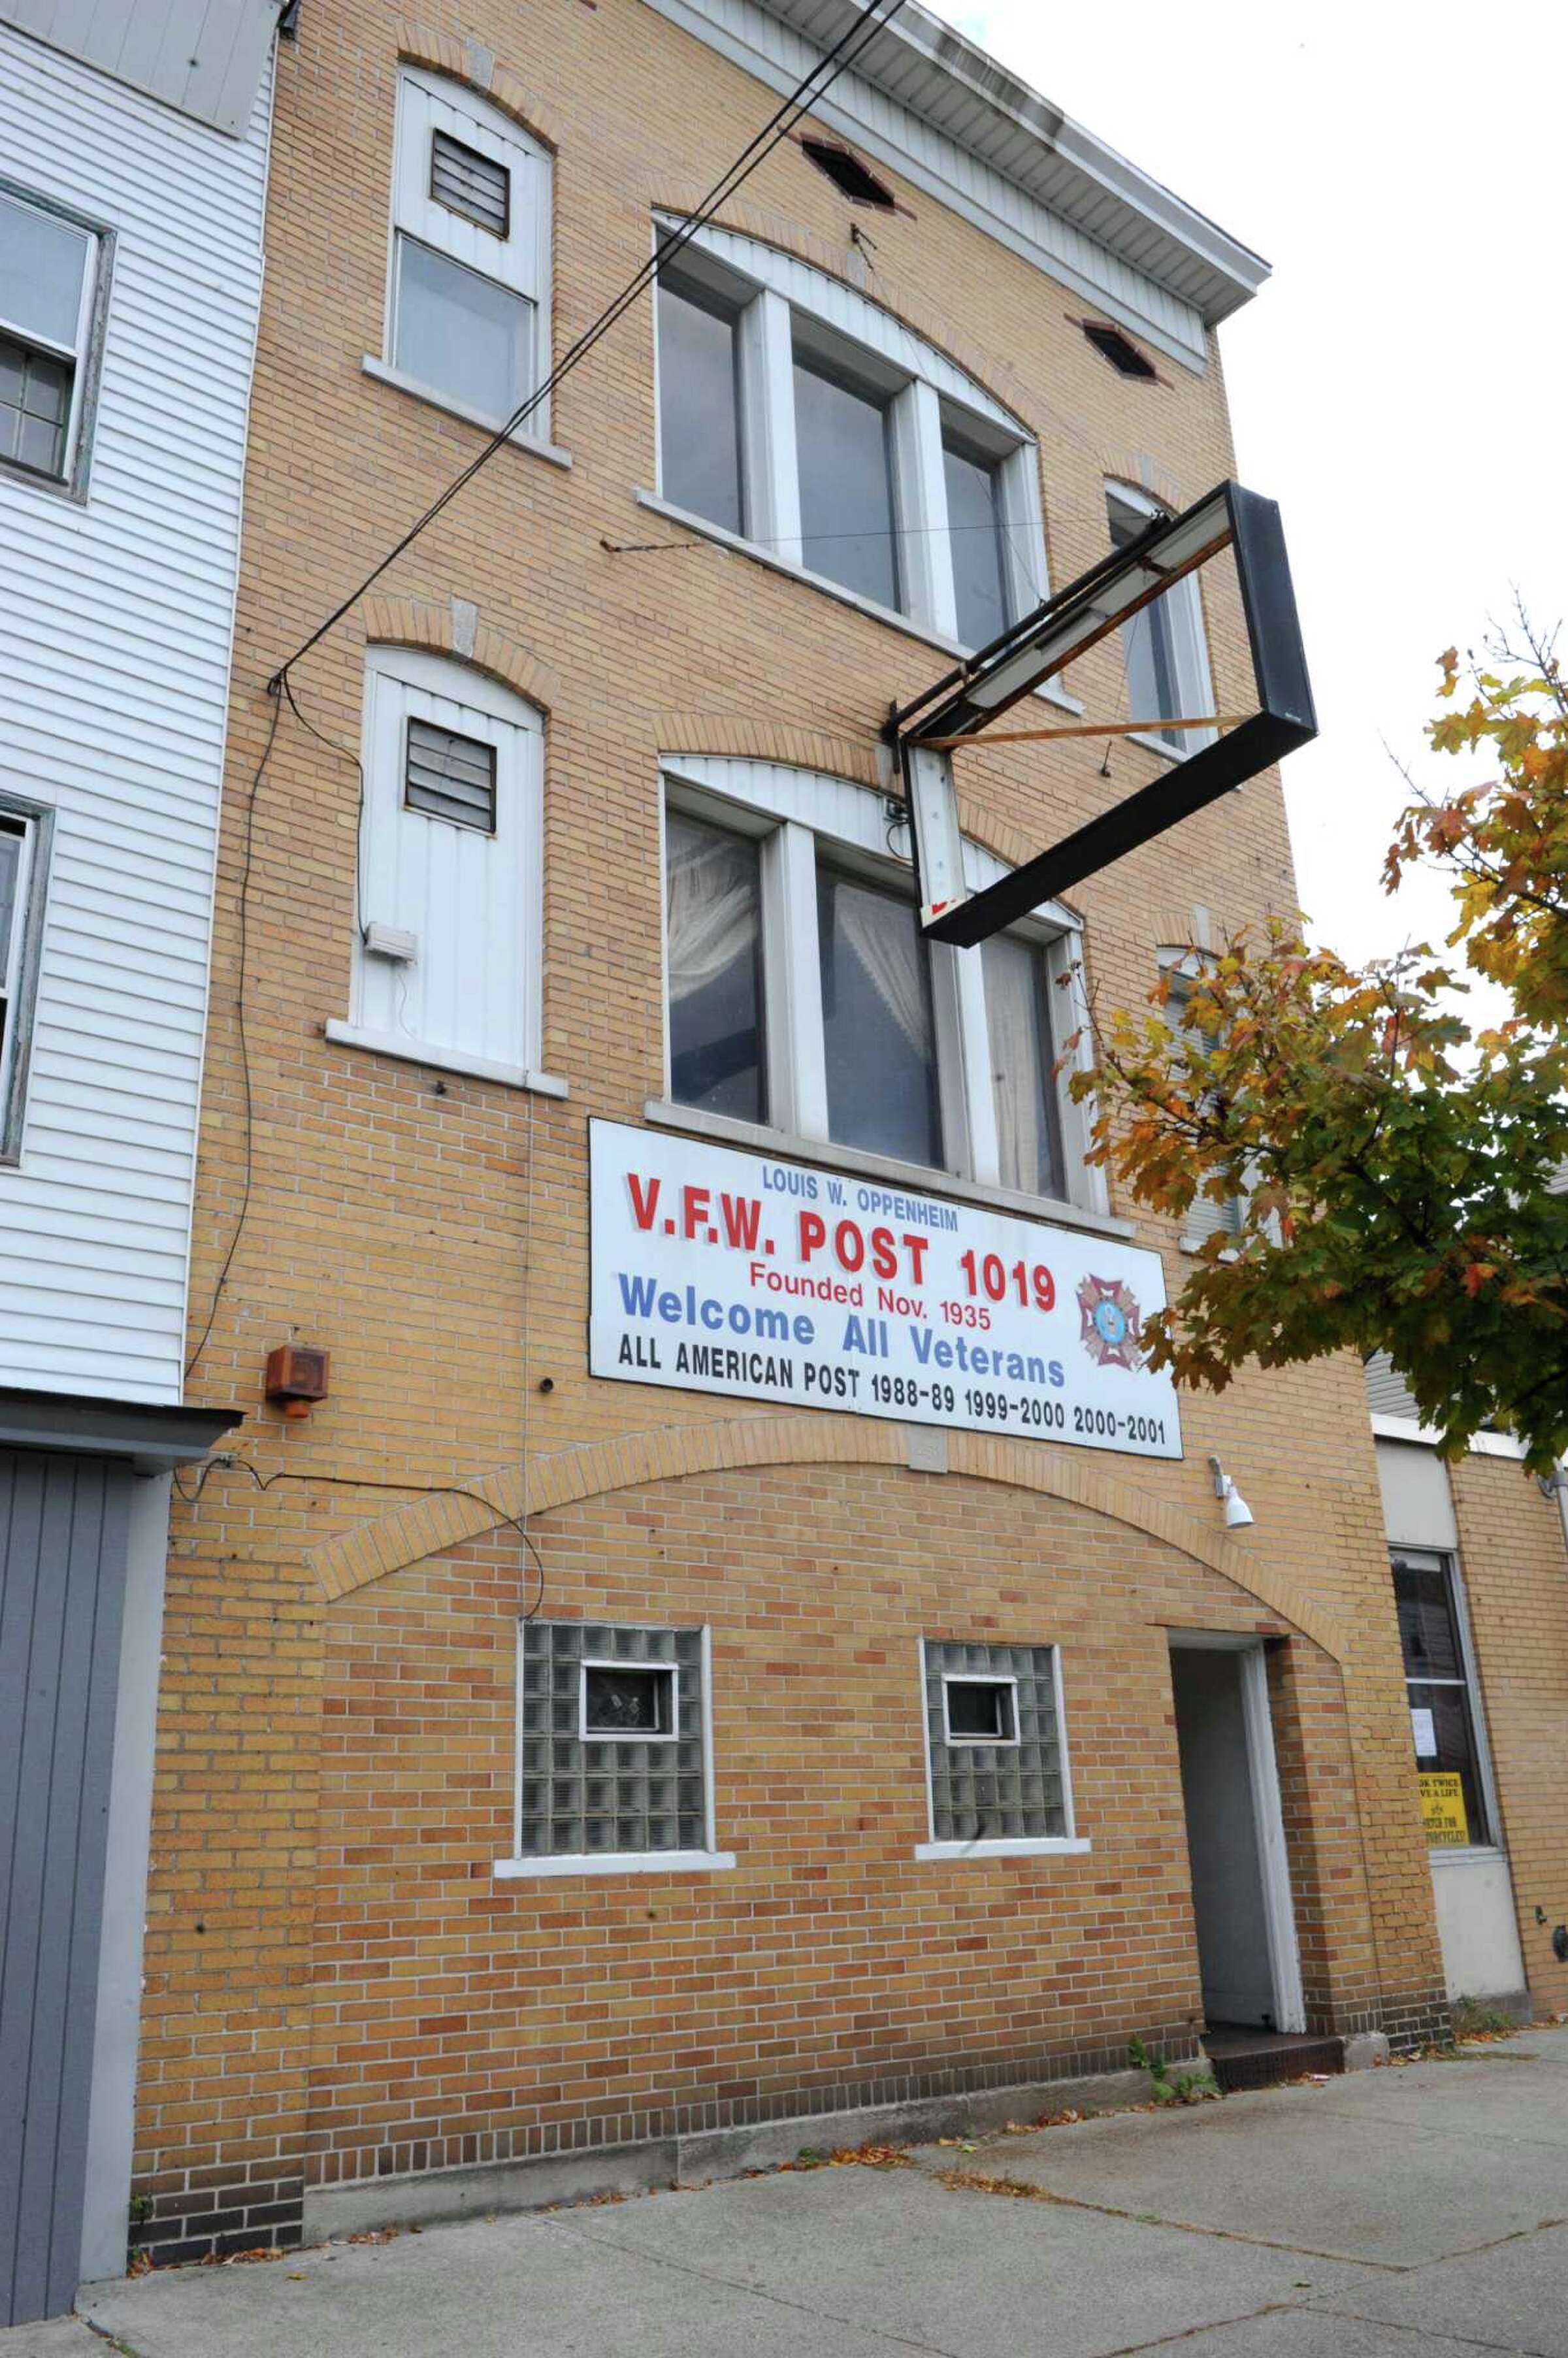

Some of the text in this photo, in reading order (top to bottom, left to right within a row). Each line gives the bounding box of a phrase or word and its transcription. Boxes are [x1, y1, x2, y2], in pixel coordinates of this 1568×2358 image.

[762, 1165, 958, 1232] LOUIS W. OPPENHEIM
[626, 1172, 1056, 1313] V.F.W. POST 1019
[618, 1272, 1065, 1388] Welcome All Veterans
[750, 1261, 991, 1331] Founded Nov. 1935
[618, 1333, 1166, 1445] ALL AMERICAN POST 1988-89 1999-2000 2000-2001
[1432, 1778, 1459, 1788] TWICE
[1441, 1788, 1459, 1797] LIFE
